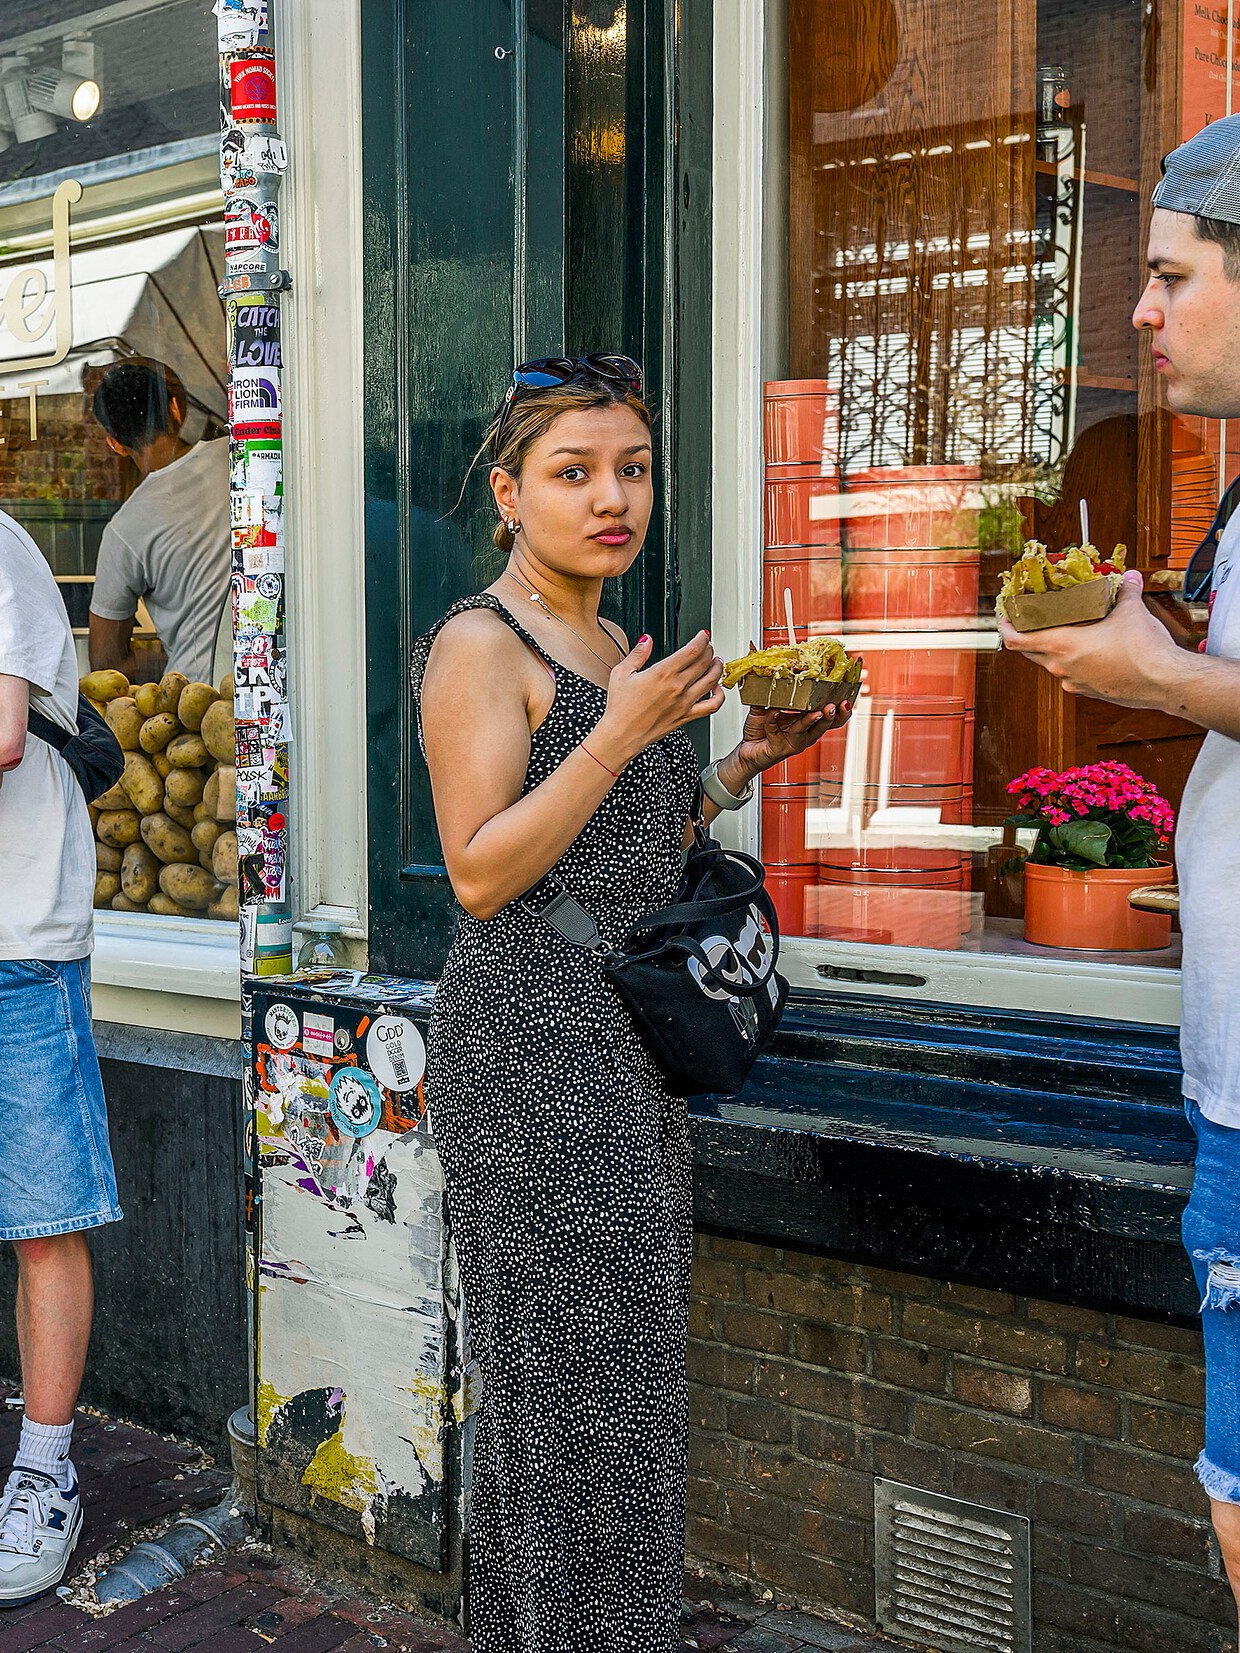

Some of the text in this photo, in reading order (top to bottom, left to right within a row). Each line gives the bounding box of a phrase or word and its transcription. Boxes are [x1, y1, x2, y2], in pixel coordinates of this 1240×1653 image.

[237, 306, 280, 327] CATCH
[254, 327, 268, 337] THE
[237, 340, 280, 366] LOVE
[234, 378, 259, 390] IRON
[235, 388, 259, 400] LION
[235, 399, 259, 409] FIRM
[376, 1024, 404, 1042] GDD
[385, 1040, 401, 1050] GOLD
